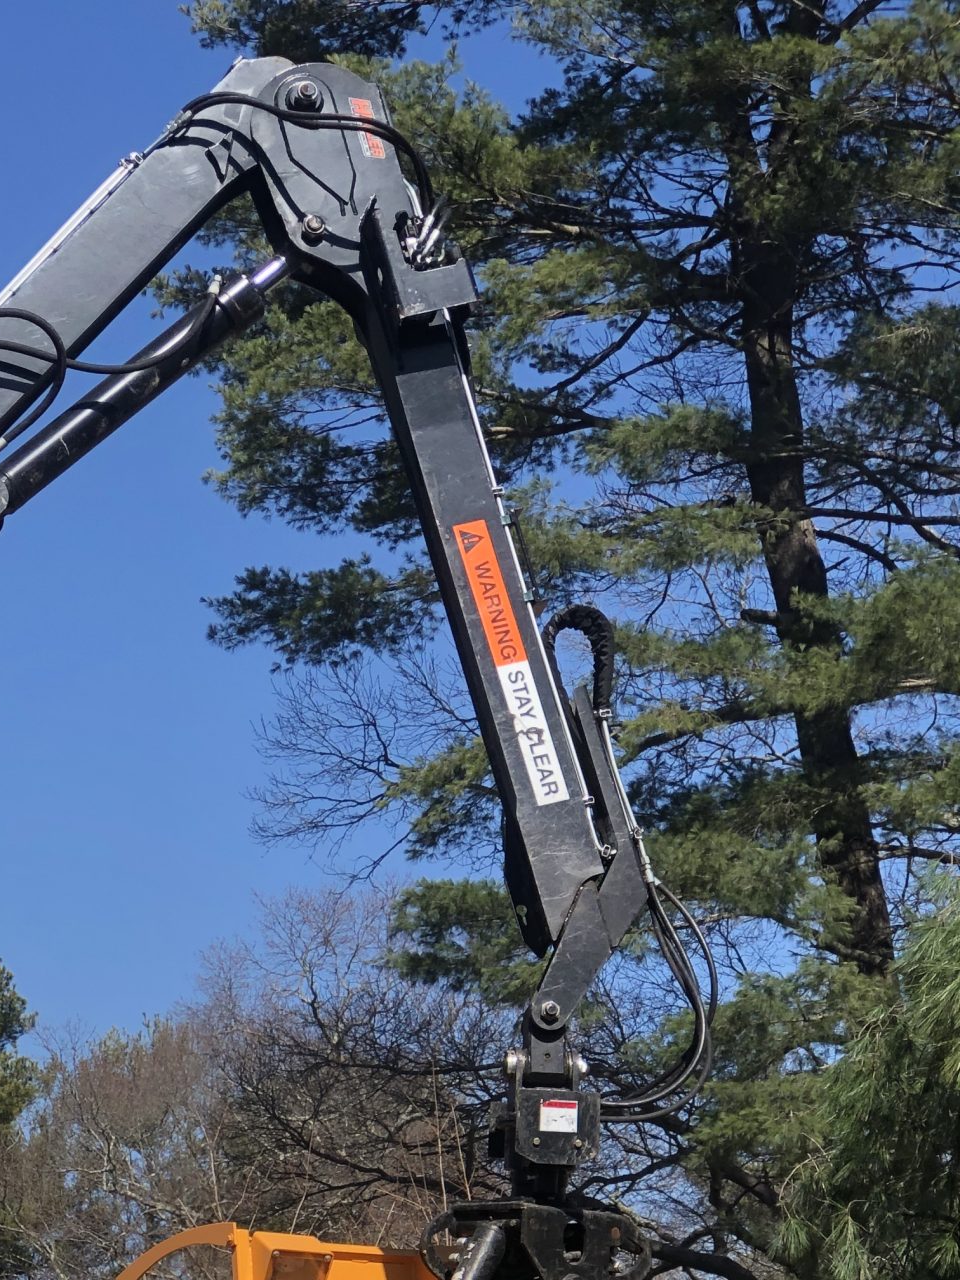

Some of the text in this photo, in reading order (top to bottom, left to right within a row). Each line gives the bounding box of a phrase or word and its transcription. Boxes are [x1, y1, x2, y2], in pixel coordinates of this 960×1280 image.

[474, 560, 517, 661] WARNING
[508, 670, 559, 797] STAY CLEAR
